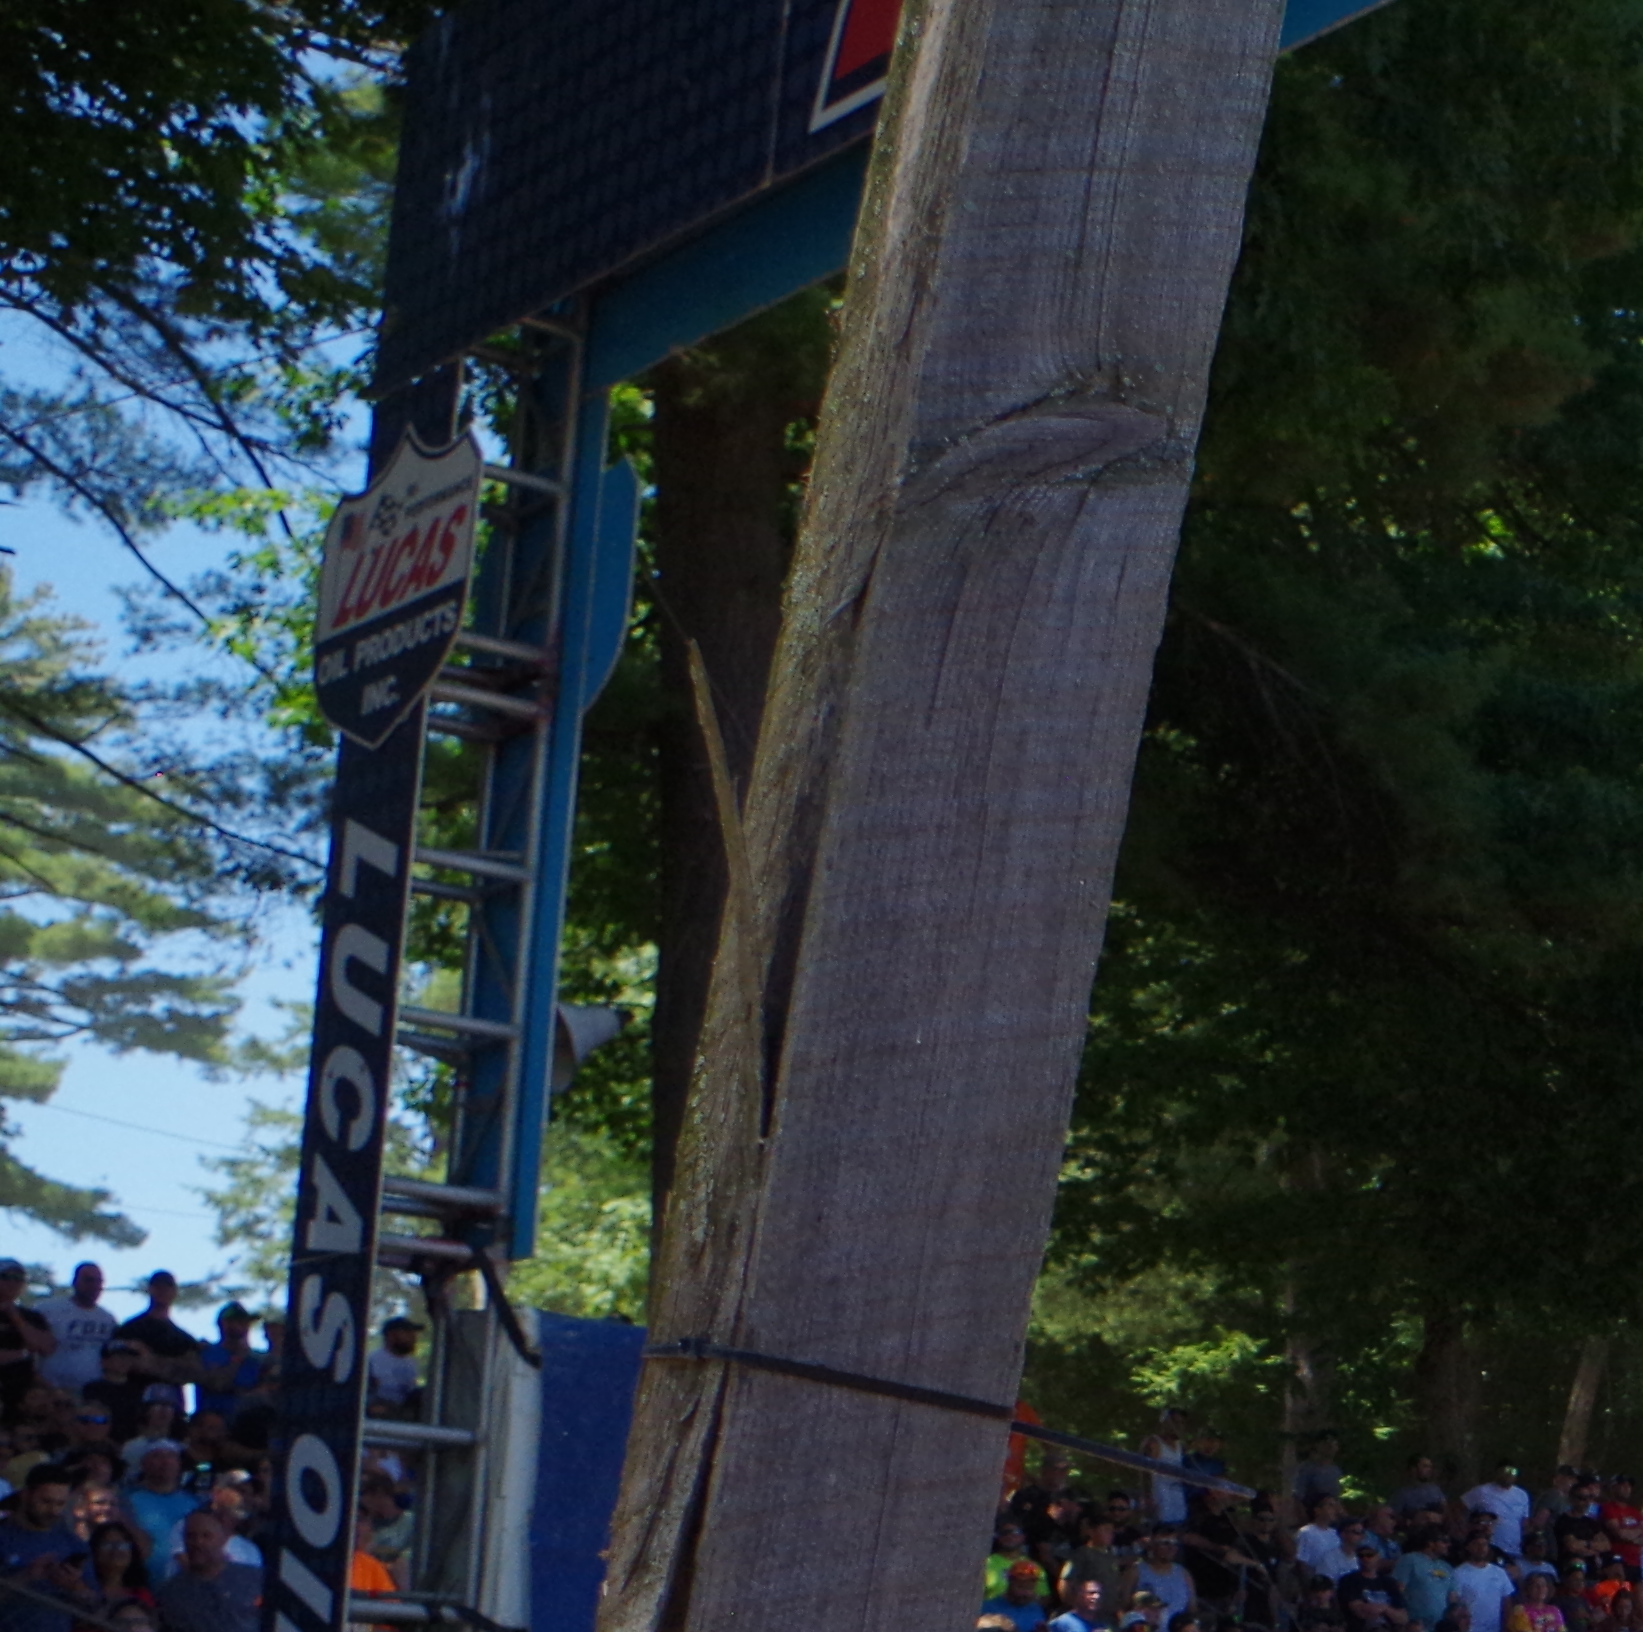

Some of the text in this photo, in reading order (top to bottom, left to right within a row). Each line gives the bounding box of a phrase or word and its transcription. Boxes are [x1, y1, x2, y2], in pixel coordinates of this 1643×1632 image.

[331, 503, 468, 630] LUCAS
[353, 600, 458, 674] PRODUCTS
[298, 818, 398, 1384] LUCAS
